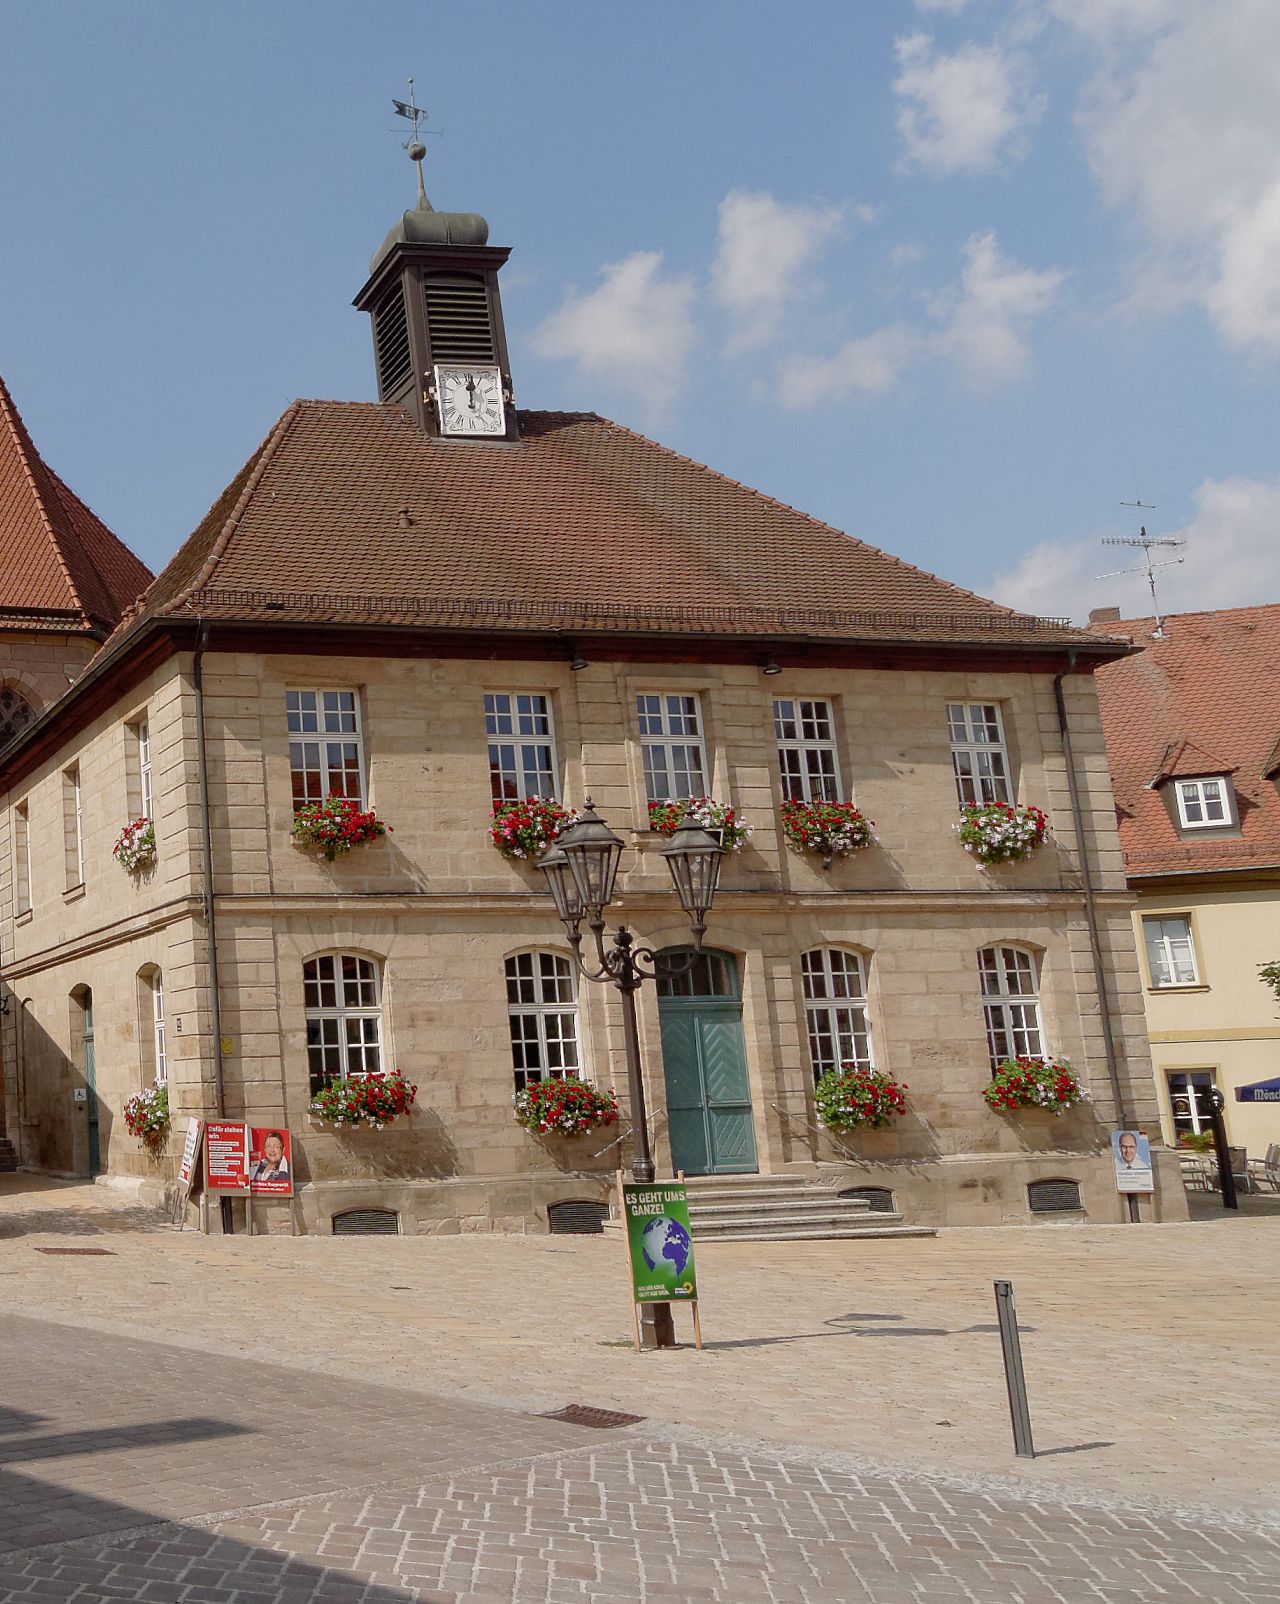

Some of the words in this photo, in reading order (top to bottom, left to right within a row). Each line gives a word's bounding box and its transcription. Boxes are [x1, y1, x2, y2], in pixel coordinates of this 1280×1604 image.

[625, 1193, 637, 1204] ES
[639, 1191, 662, 1203] GEHT
[664, 1190, 685, 1202] UMS
[631, 1203, 665, 1216] GANZE!
